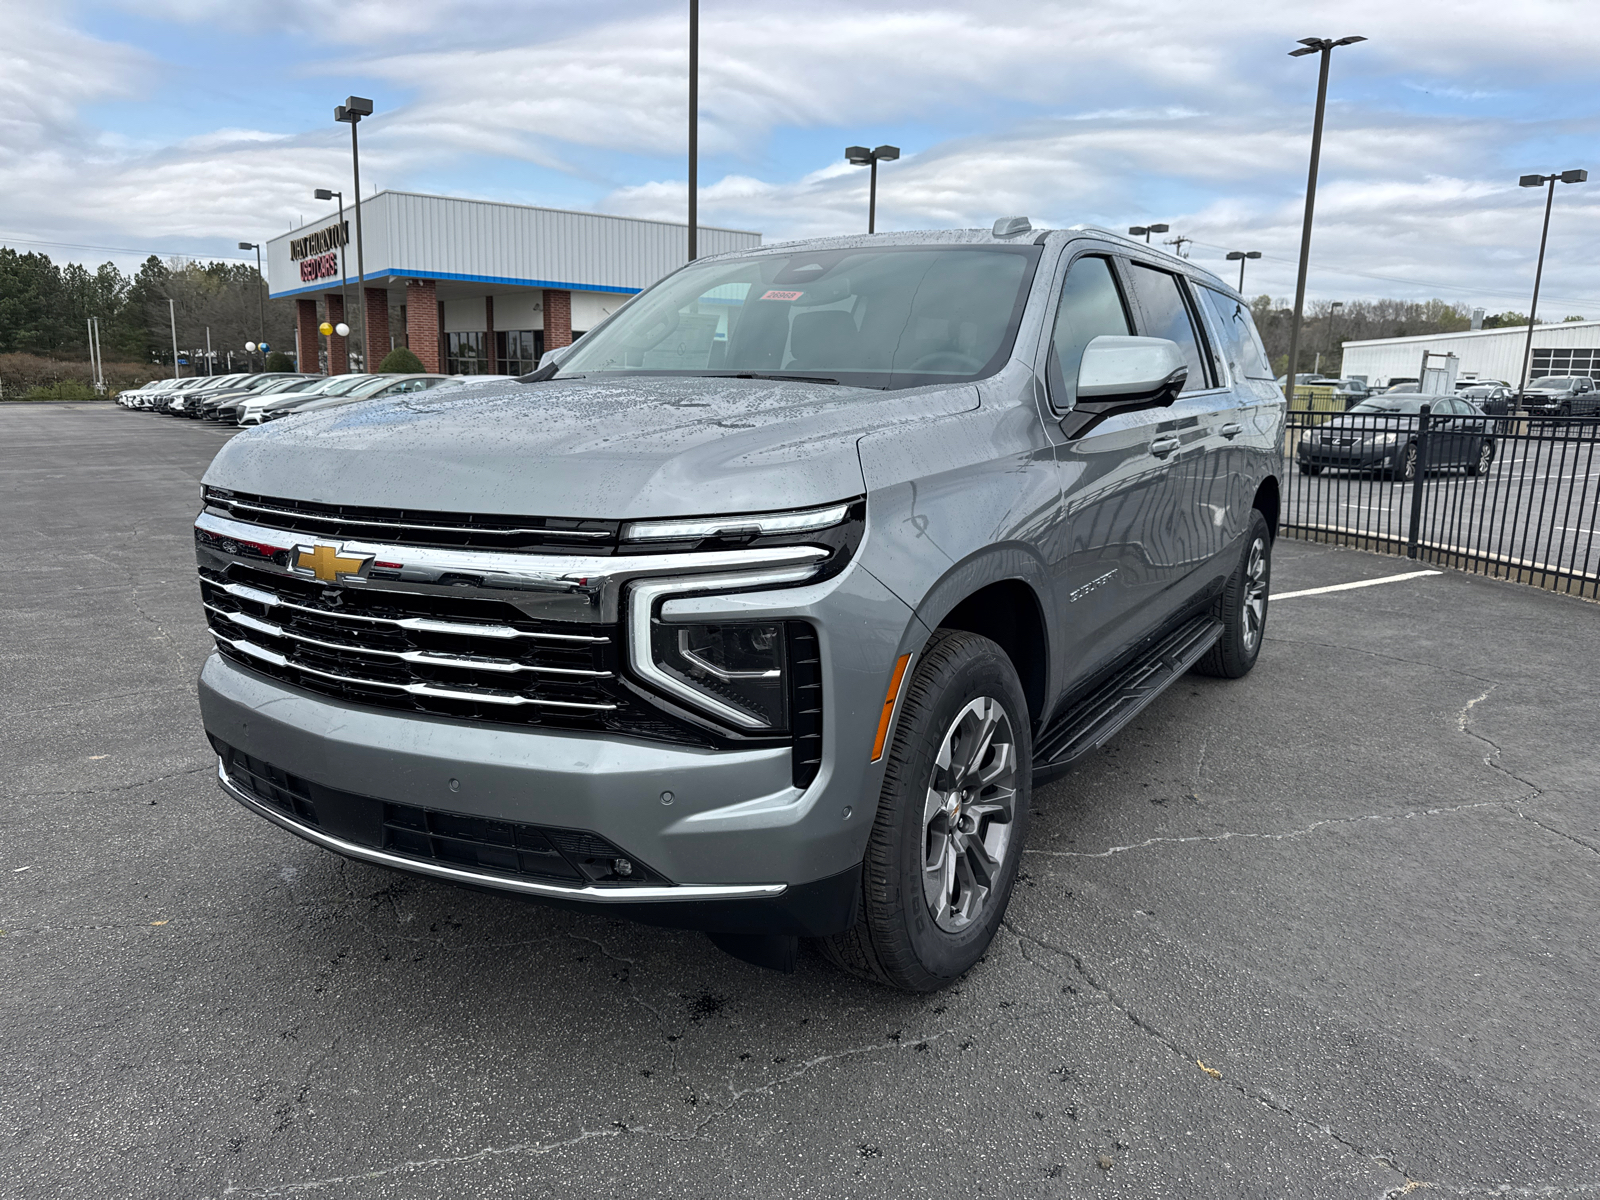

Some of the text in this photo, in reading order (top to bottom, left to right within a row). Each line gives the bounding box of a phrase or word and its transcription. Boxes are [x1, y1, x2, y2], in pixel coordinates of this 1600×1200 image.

[290, 220, 349, 261] JOHN THORNTON
[300, 252, 336, 282] USED CARS
